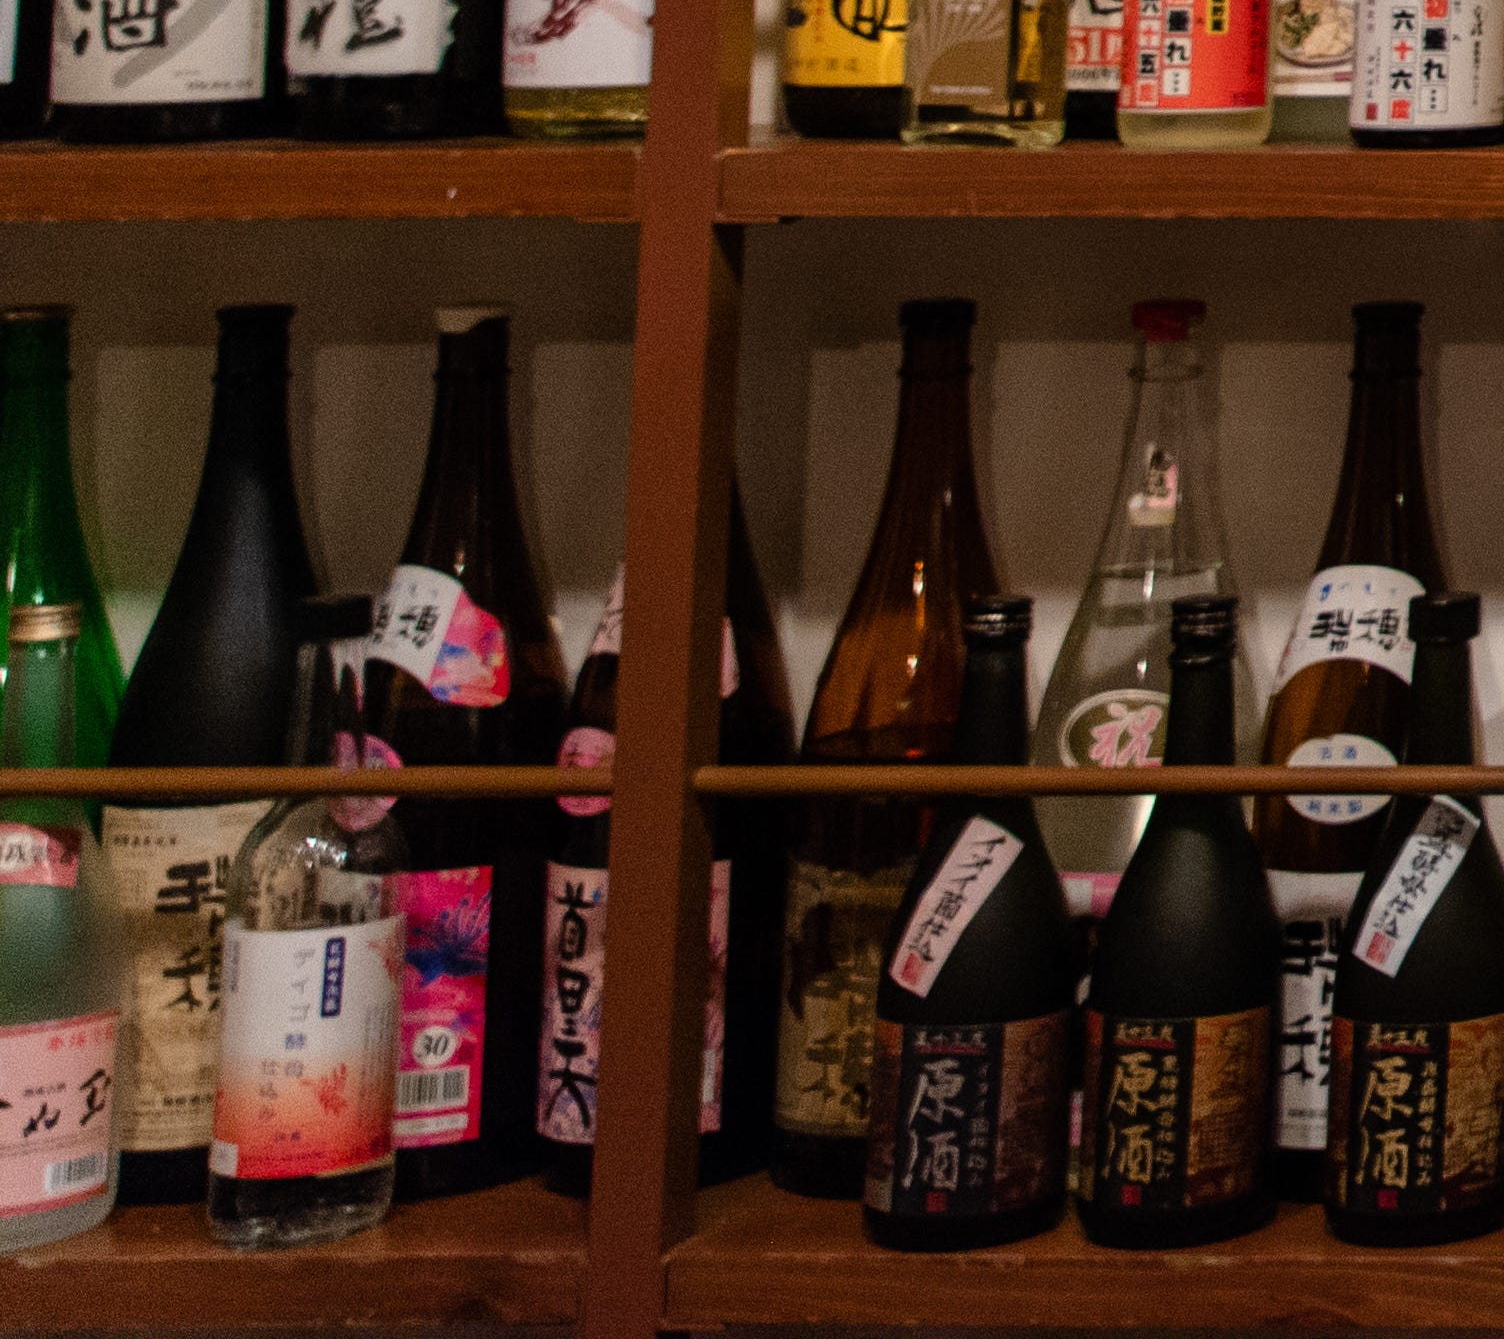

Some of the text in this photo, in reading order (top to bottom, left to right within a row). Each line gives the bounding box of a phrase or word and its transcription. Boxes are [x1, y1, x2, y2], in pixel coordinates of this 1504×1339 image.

[904, 1056, 968, 1193] 原酒
[1101, 1051, 1162, 1188] 原酒
[1354, 1054, 1414, 1191] 原酒
